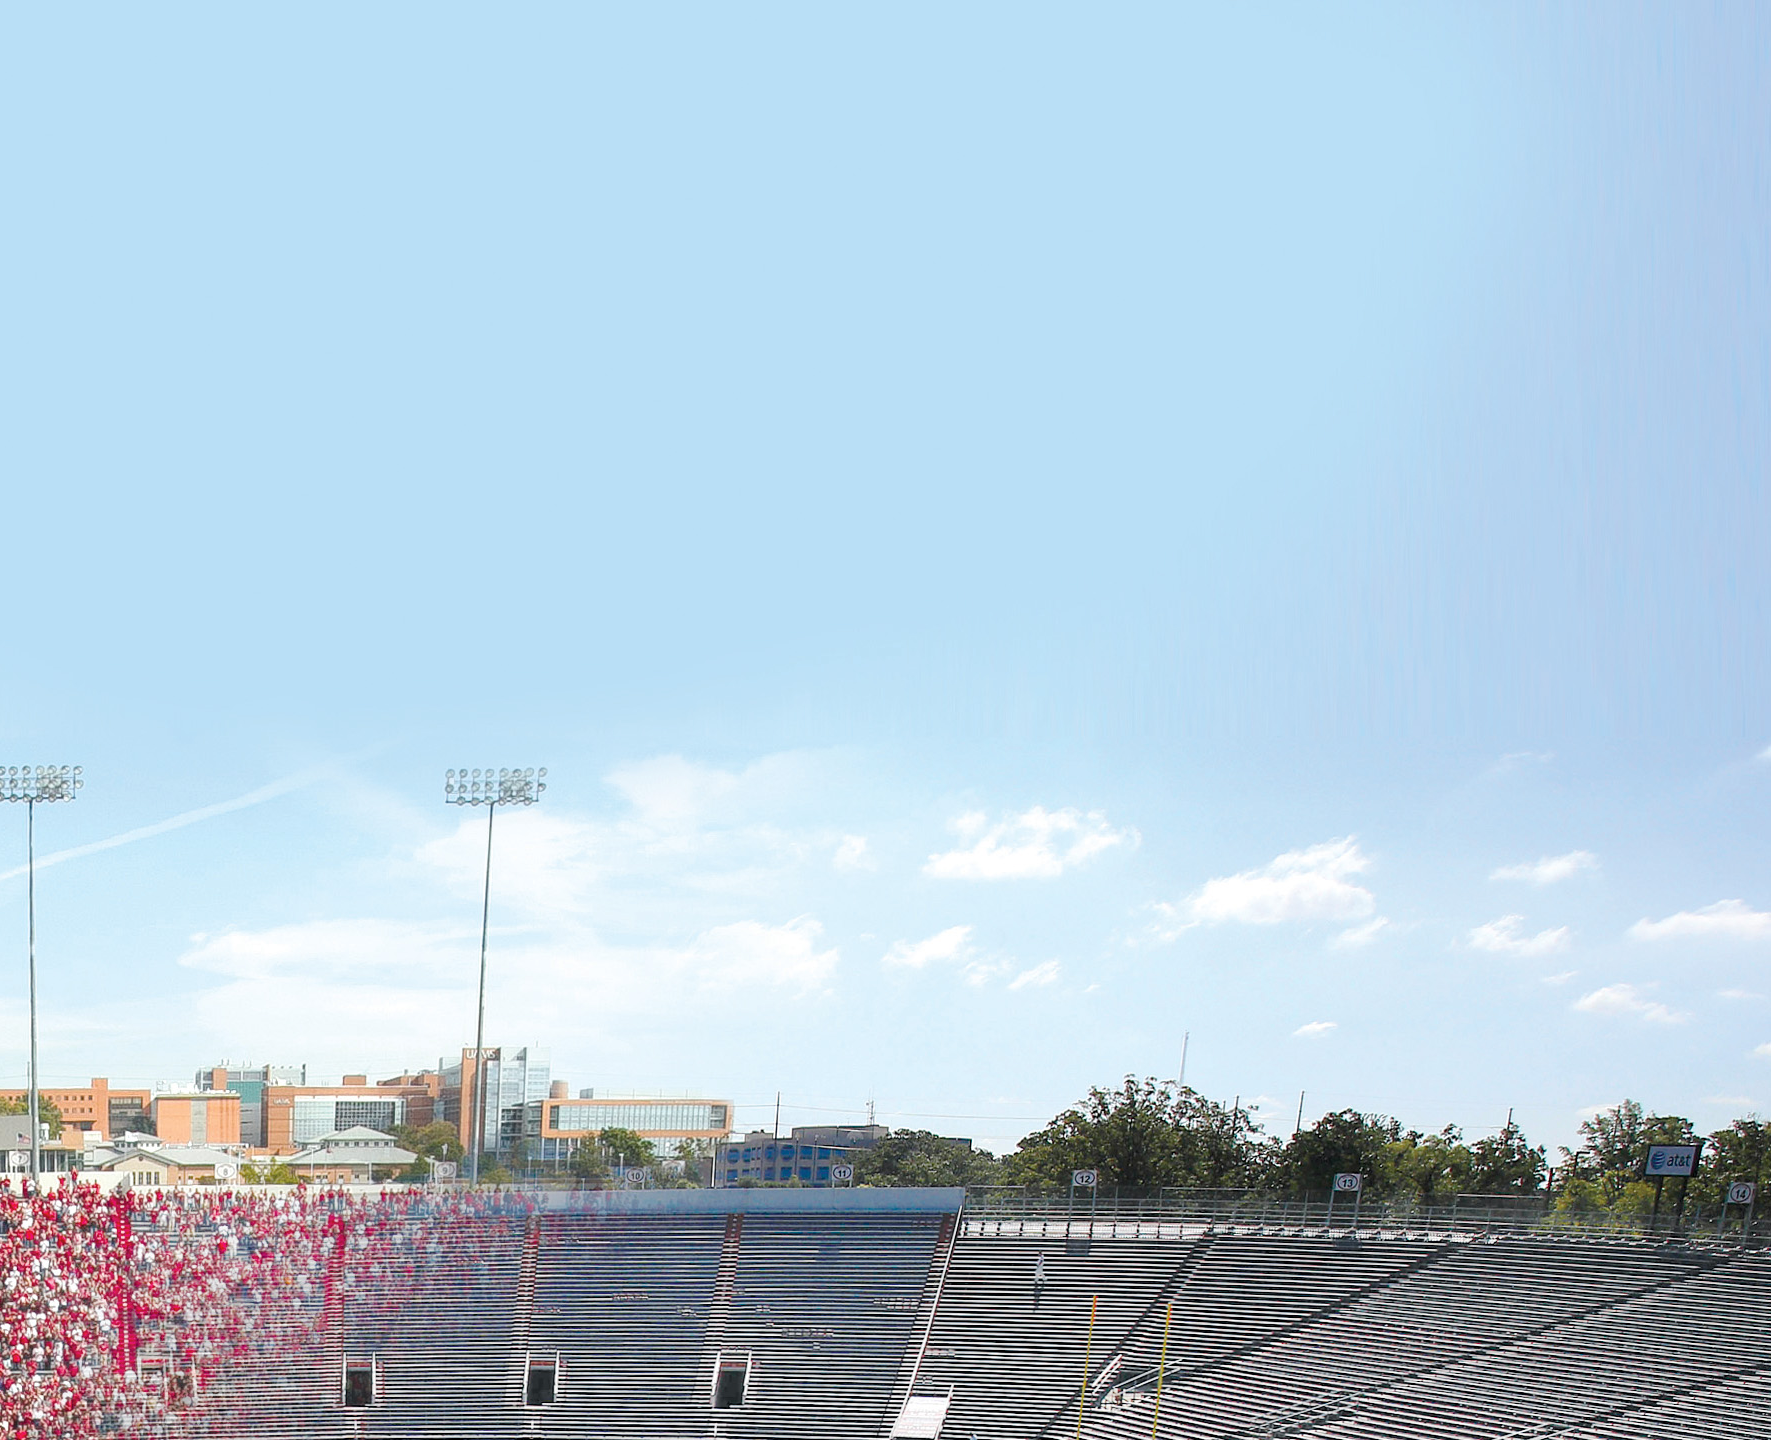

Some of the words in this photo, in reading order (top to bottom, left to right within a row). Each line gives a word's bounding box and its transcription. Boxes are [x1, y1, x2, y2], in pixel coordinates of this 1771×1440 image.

[1666, 1153, 1691, 1167] at&t
[631, 1172, 640, 1181] 10
[838, 1168, 847, 1178] 11
[1079, 1174, 1091, 1184] 12
[1342, 1177, 1352, 1188] 13
[1734, 1187, 1746, 1199] 14
